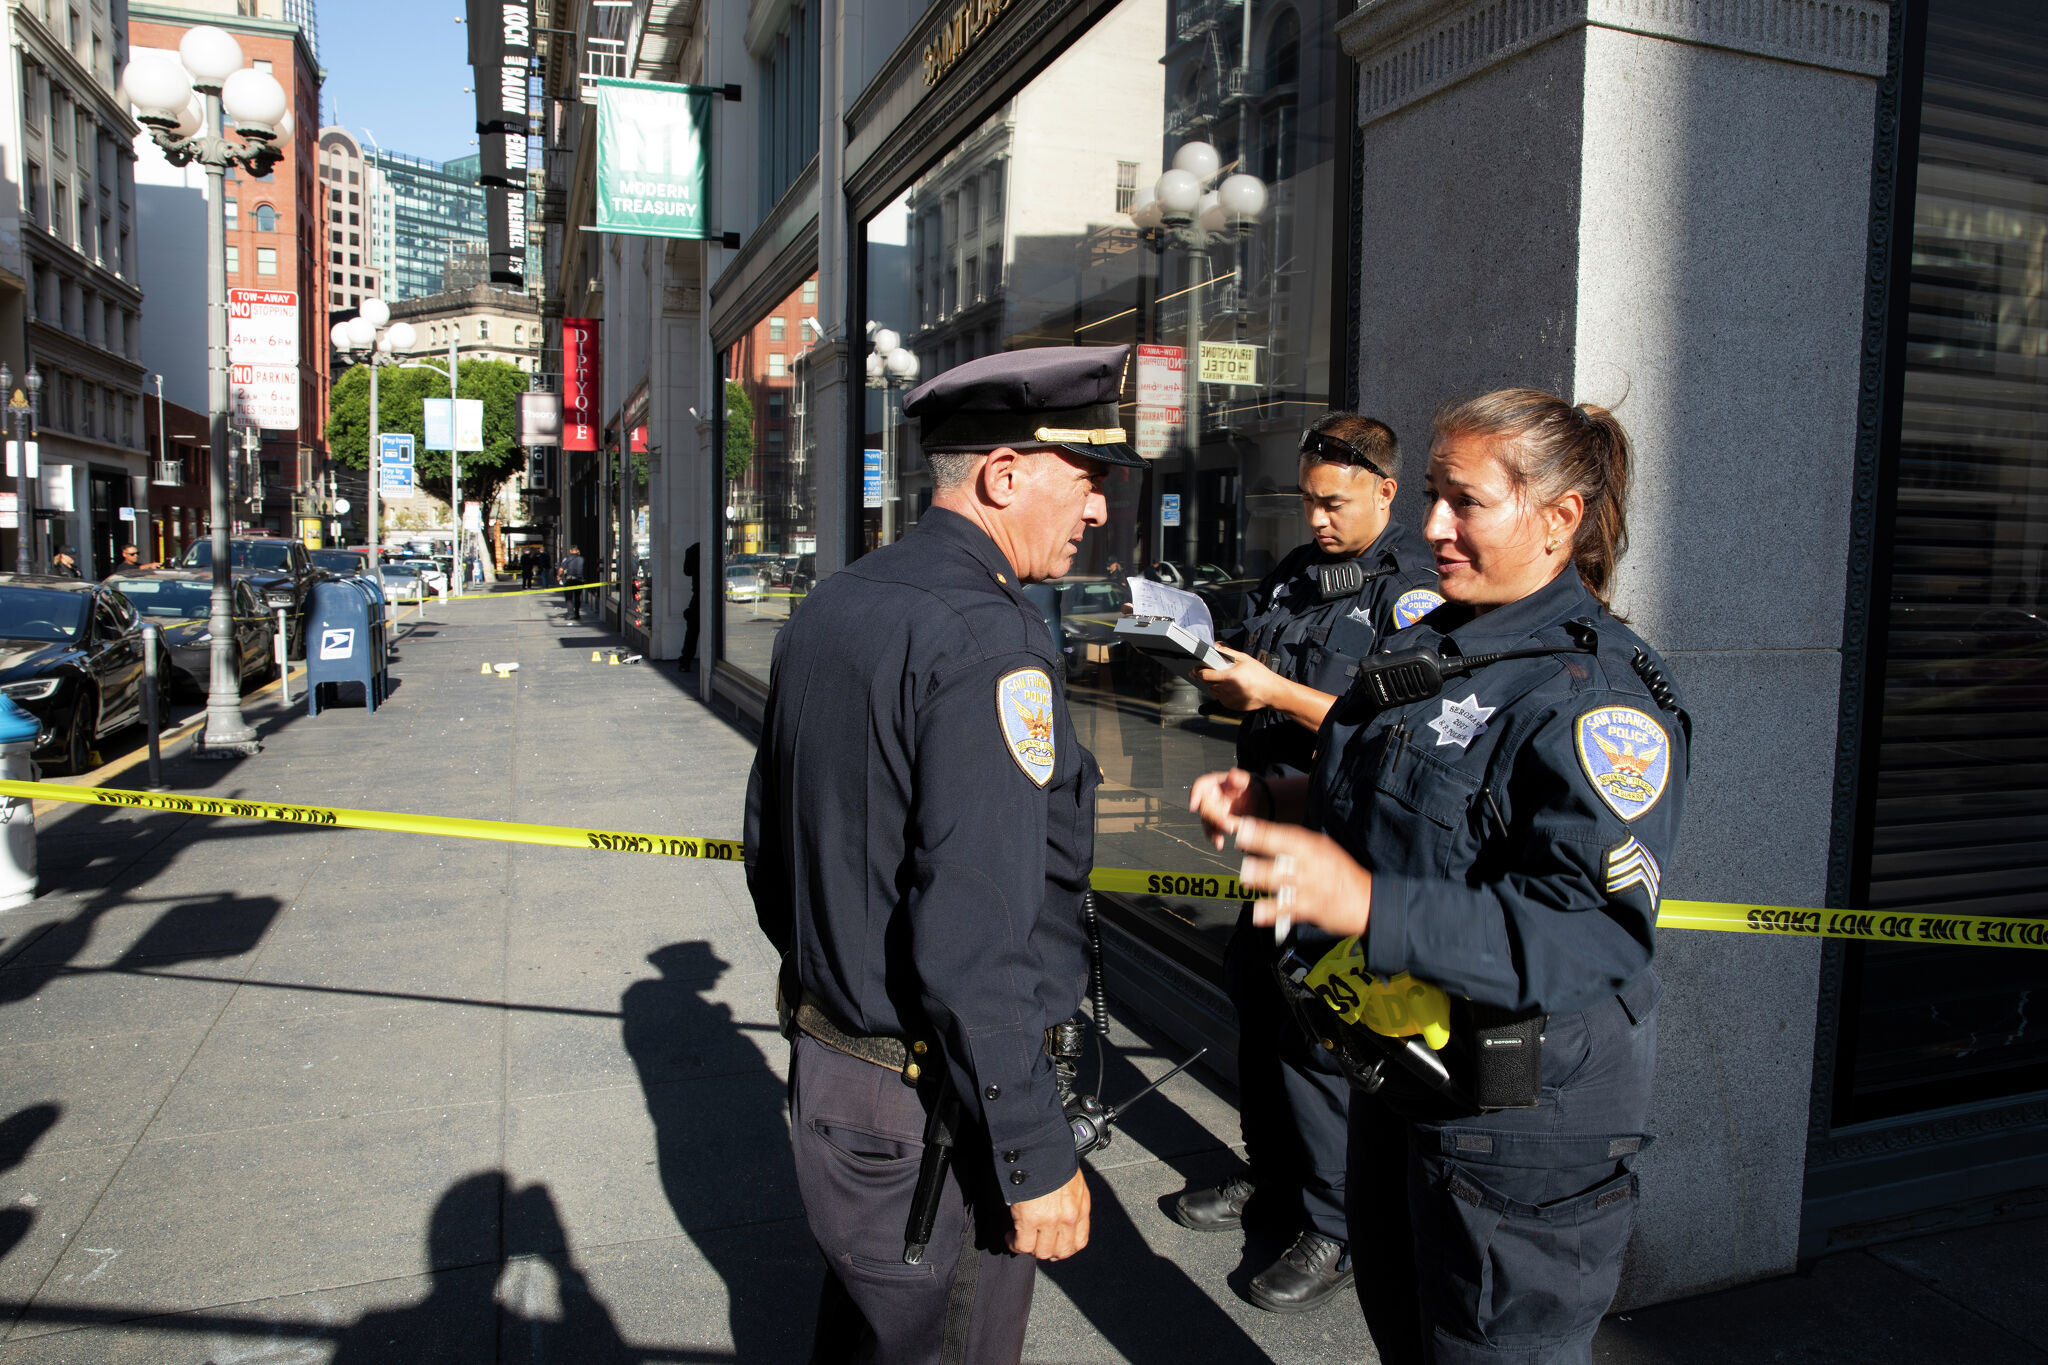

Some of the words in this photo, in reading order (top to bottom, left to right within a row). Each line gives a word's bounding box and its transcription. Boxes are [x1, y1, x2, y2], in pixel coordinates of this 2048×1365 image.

[503, 4, 529, 47] KOCH
[501, 67, 526, 115] BAUM
[619, 180, 689, 199] MODERN
[612, 198, 697, 217] TREASURY
[508, 193, 525, 248] FRAENKEL
[237, 292, 290, 304] TOW-AWAY
[231, 302, 250, 317] NO
[253, 305, 294, 317] STOPPING
[233, 366, 252, 383] NO
[257, 371, 296, 385] PARKING
[574, 329, 588, 439] DIPTYQUE
[237, 404, 256, 415] TUES
[280, 406, 295, 417] SUN
[522, 409, 557, 421] Theory
[1408, 601, 1434, 609] POLICE
[1410, 592, 1444, 606] FRANCISCO
[1006, 676, 1027, 694] SAN
[1586, 712, 1610, 731] SAN
[1611, 711, 1665, 744] FRANCISCO
[1608, 725, 1650, 745] POLICE
[587, 832, 653, 854] CROSS
[659, 838, 698, 858] NOT
[704, 842, 733, 860] DO
[1148, 874, 1219, 897] CROSS
[1747, 909, 1822, 933] CROSS
[1826, 913, 1876, 937] NOT
[1880, 916, 1914, 938] DO
[1919, 918, 1973, 942] LINE
